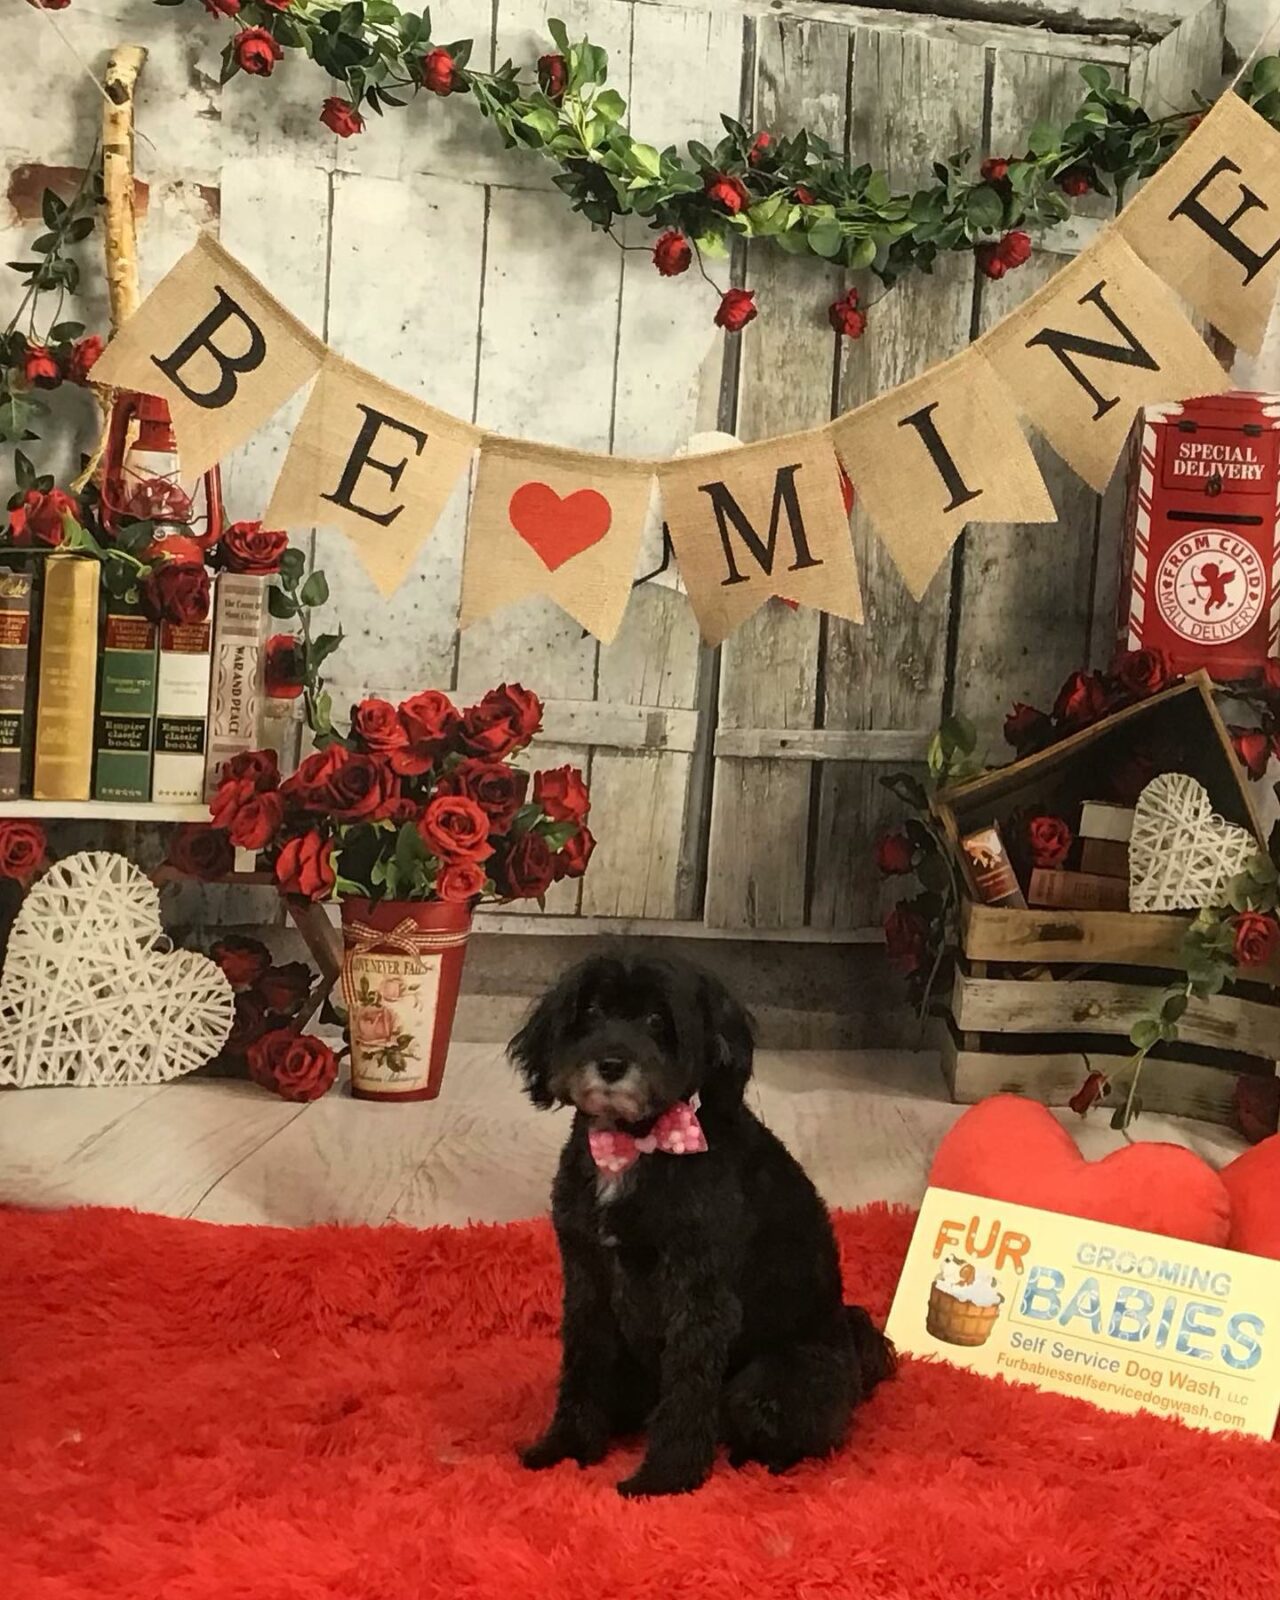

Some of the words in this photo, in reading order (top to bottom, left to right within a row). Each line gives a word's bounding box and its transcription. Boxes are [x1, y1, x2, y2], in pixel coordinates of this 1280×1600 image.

[1179, 442, 1257, 463] SPECIAL
[1173, 460, 1265, 480] DELIVERY
[1163, 536, 1210, 578] FROM
[1219, 538, 1260, 587] CUPID
[1190, 601, 1257, 639] DELIVERY
[233, 646, 245, 671] WAR
[232, 672, 242, 697] AND
[104, 721, 146, 732] Empire
[107, 731, 142, 740] classic
[162, 722, 202, 734] Empire
[164, 732, 198, 742] classic
[107, 739, 142, 748] books
[165, 741, 198, 750] books
[932, 1215, 1031, 1275] FUR
[1076, 1243, 1233, 1297] GROOMING
[1019, 1266, 1265, 1370] BABIES
[1010, 1332, 1048, 1354] Self
[1051, 1342, 1121, 1373] Service
[1125, 1360, 1164, 1387] Dog
[1168, 1371, 1222, 1399] Wash
[996, 1352, 1247, 1428] Furbabiesselfservicedogwash.com
